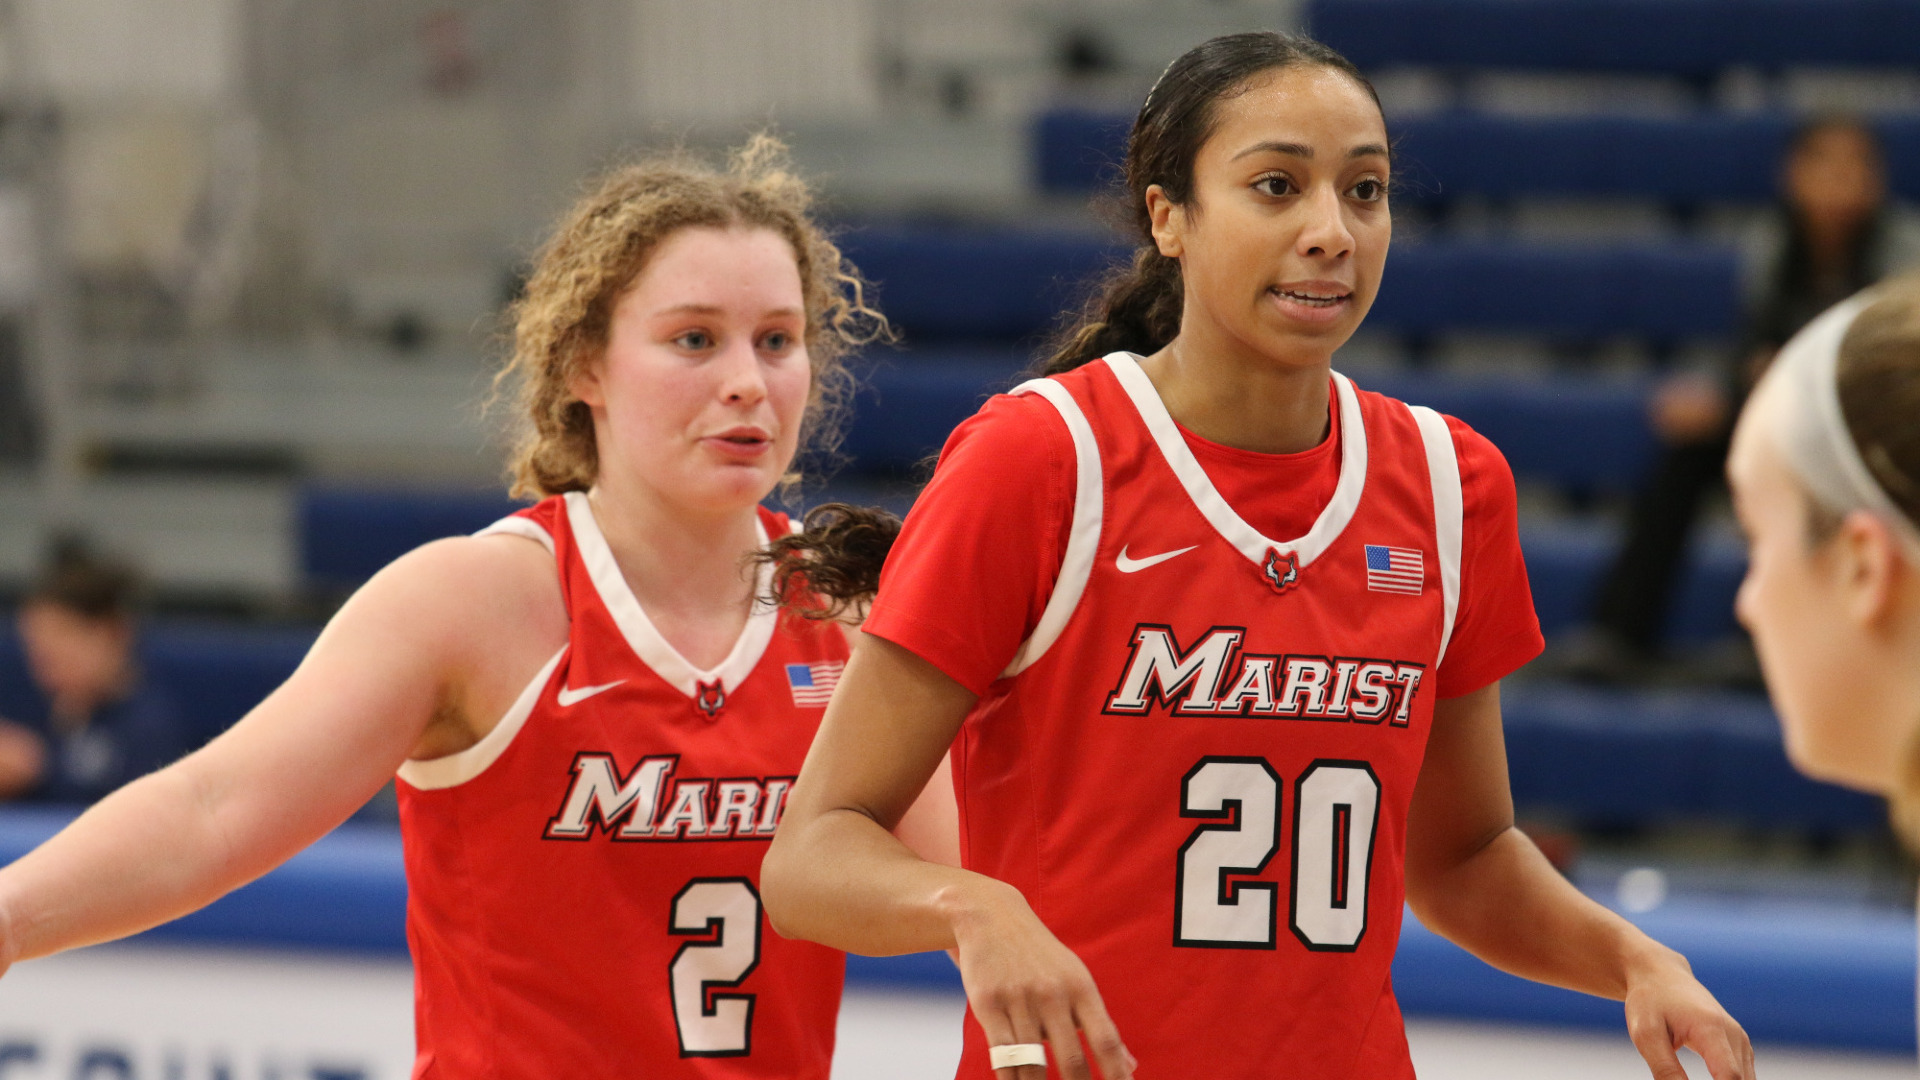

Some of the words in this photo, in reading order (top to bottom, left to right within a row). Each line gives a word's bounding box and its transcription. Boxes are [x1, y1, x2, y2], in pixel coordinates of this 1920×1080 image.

[542, 751, 798, 842] MARI
[1173, 755, 1381, 953] 20
[667, 876, 761, 1058] 2
